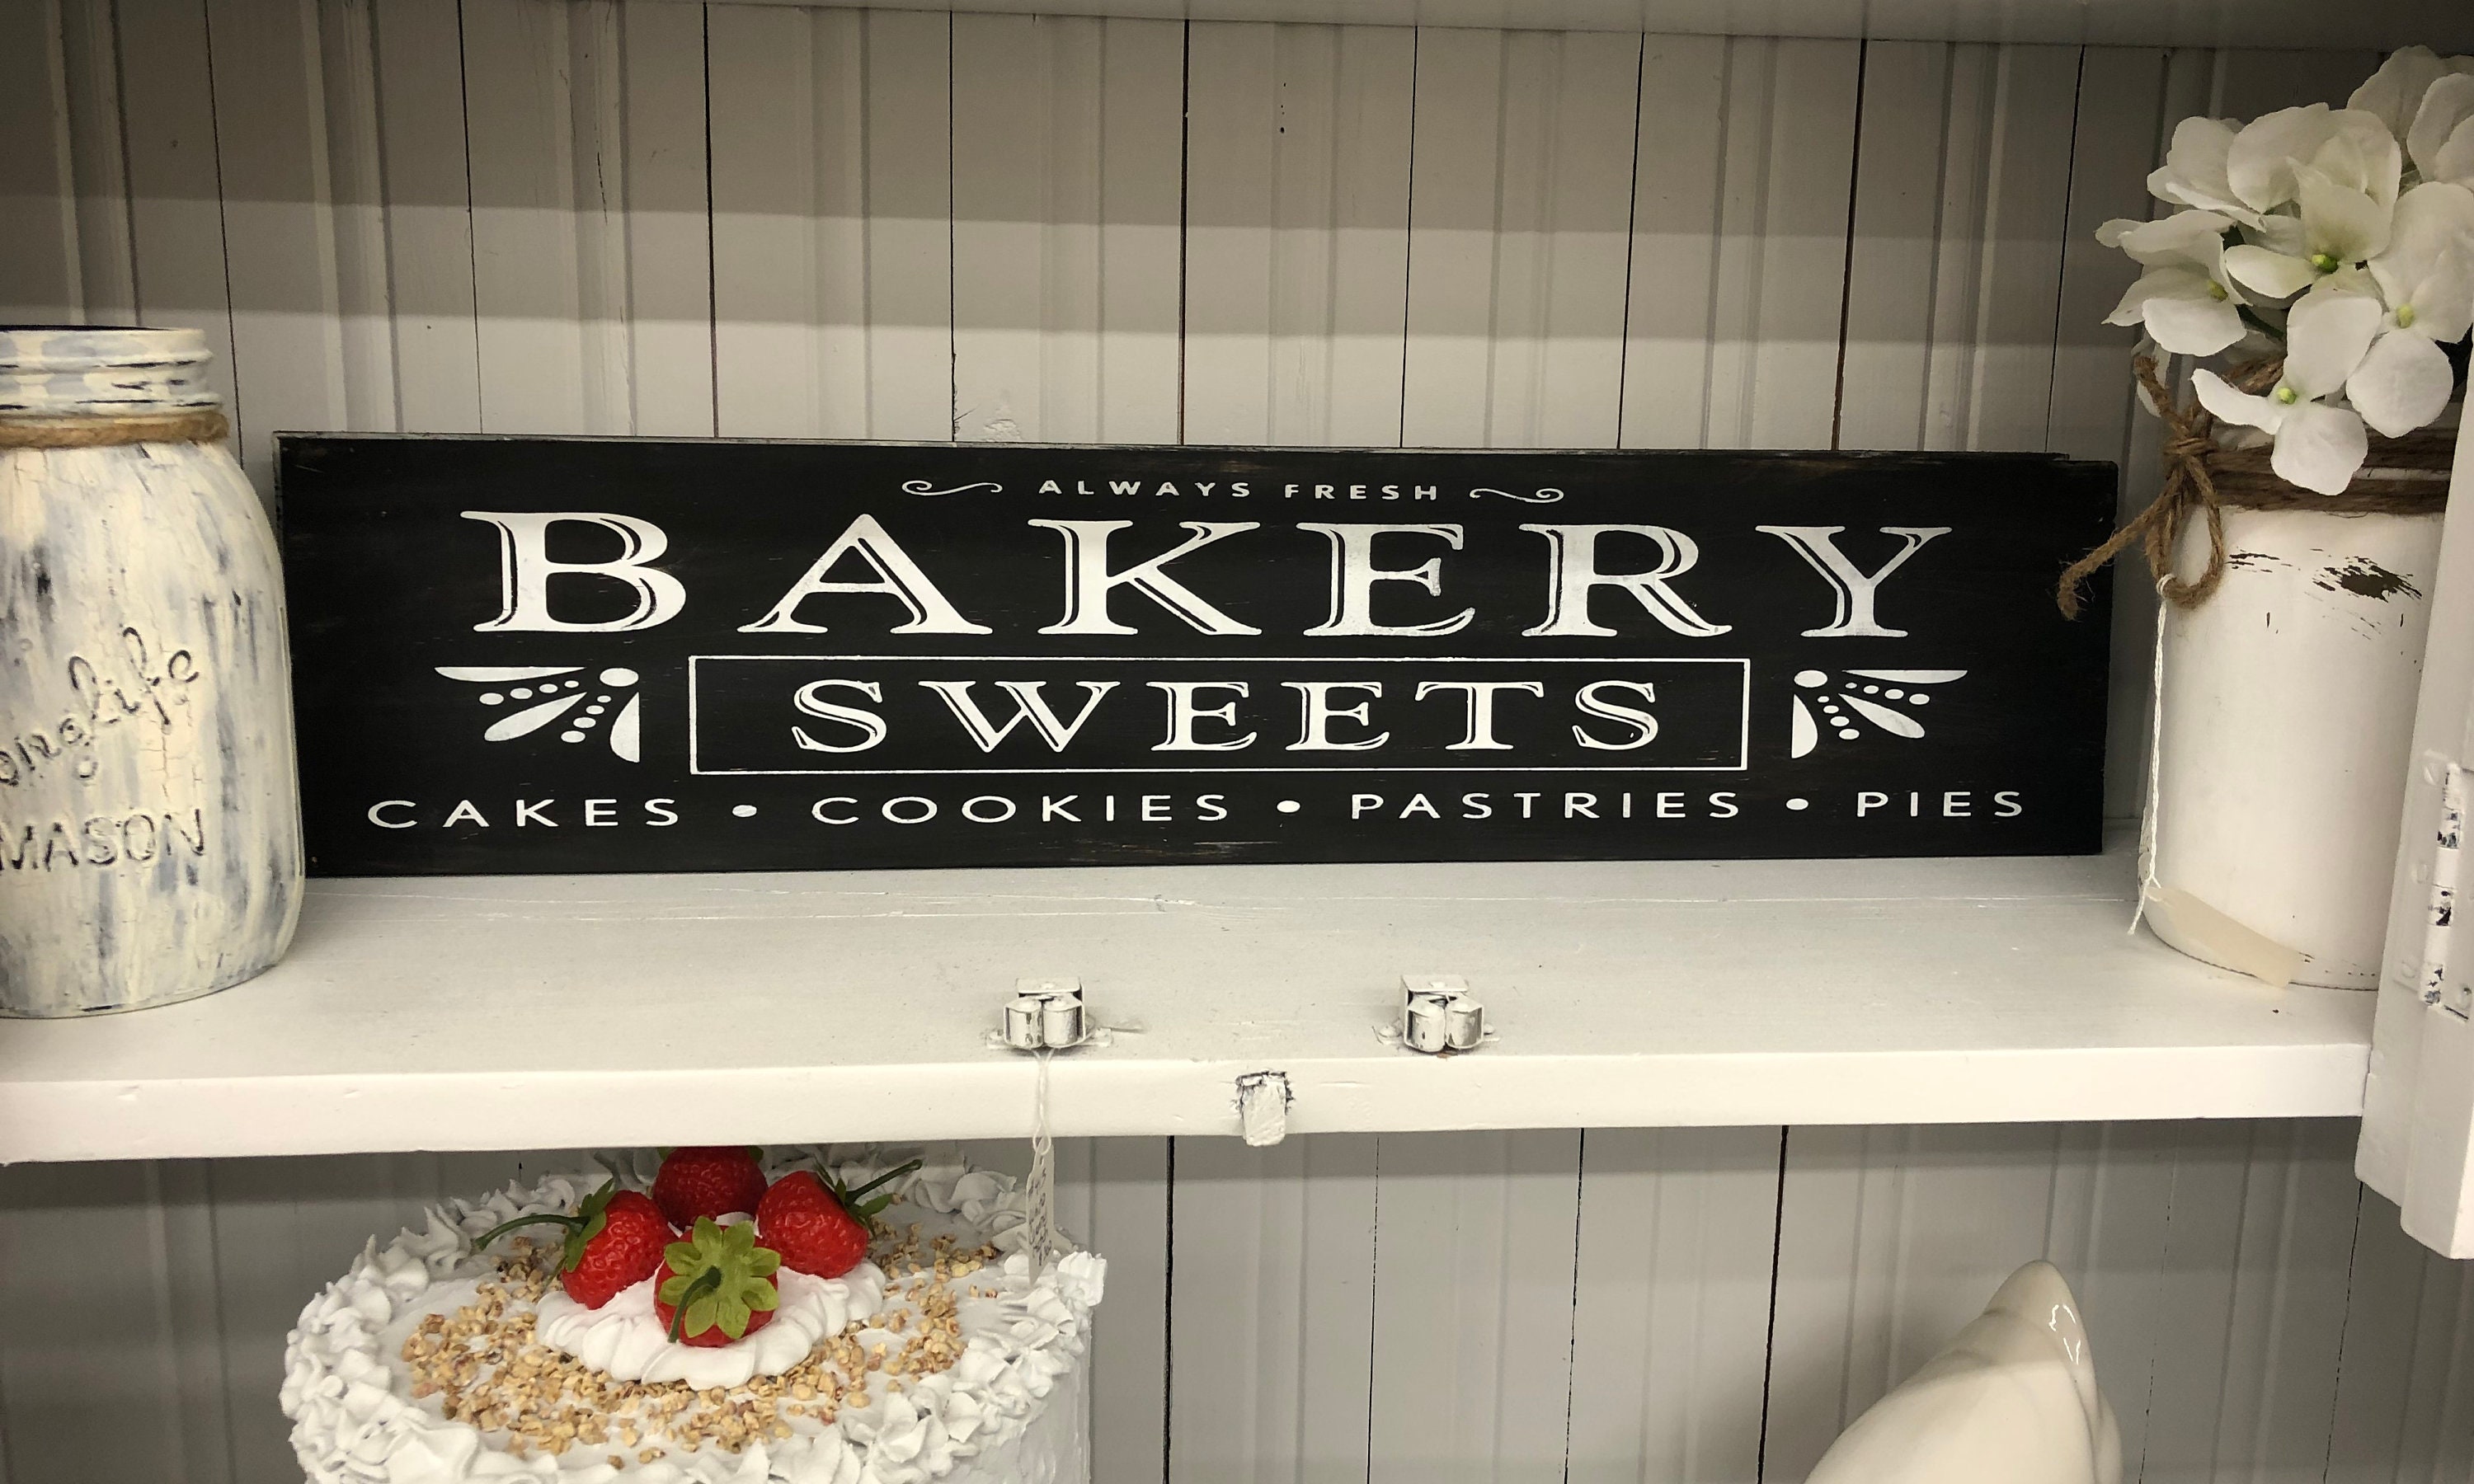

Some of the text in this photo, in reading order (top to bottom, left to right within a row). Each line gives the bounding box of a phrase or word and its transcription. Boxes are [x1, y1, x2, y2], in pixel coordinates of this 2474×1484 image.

[1038, 479, 1437, 501] ALWAYS FRESH
[459, 510, 1952, 638] BAKERY
[791, 679, 1659, 754] SWEETS
[0, 808, 205, 871] MASON
[367, 791, 2023, 829] CAKES COOKIES PASTRIES PIES
